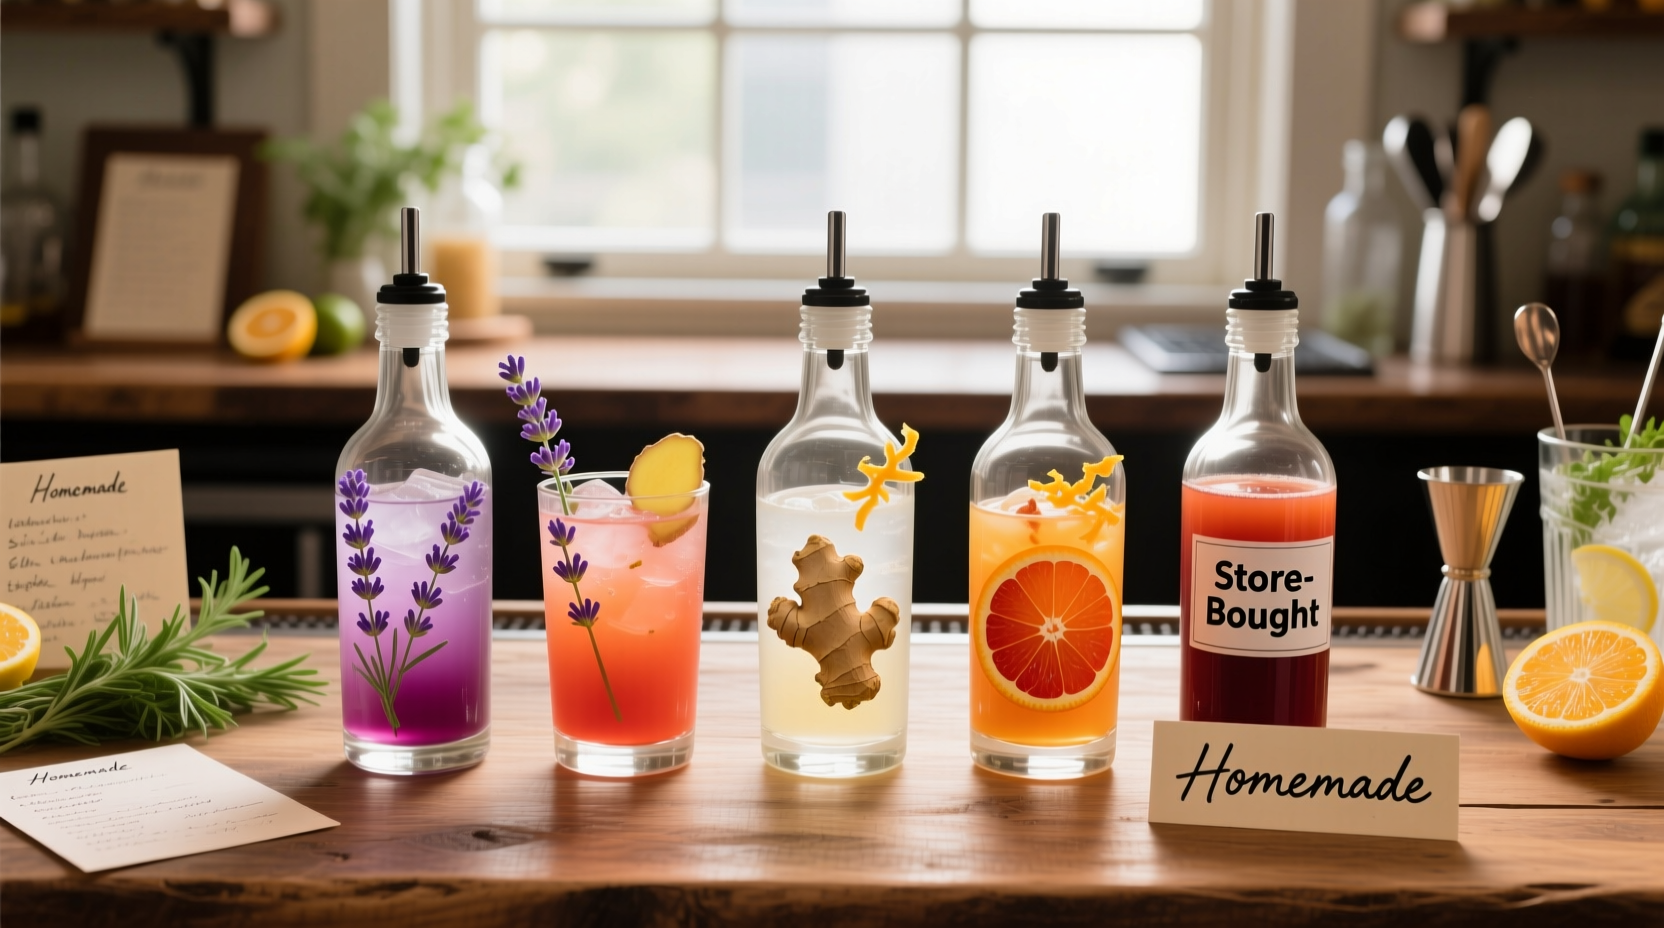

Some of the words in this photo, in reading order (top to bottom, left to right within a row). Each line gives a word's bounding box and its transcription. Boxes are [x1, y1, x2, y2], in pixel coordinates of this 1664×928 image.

[1214, 560, 1314, 593] Store-
[1206, 595, 1319, 638] Bought
[28, 761, 132, 786] Homemade
[1175, 742, 1432, 804] Homemade
